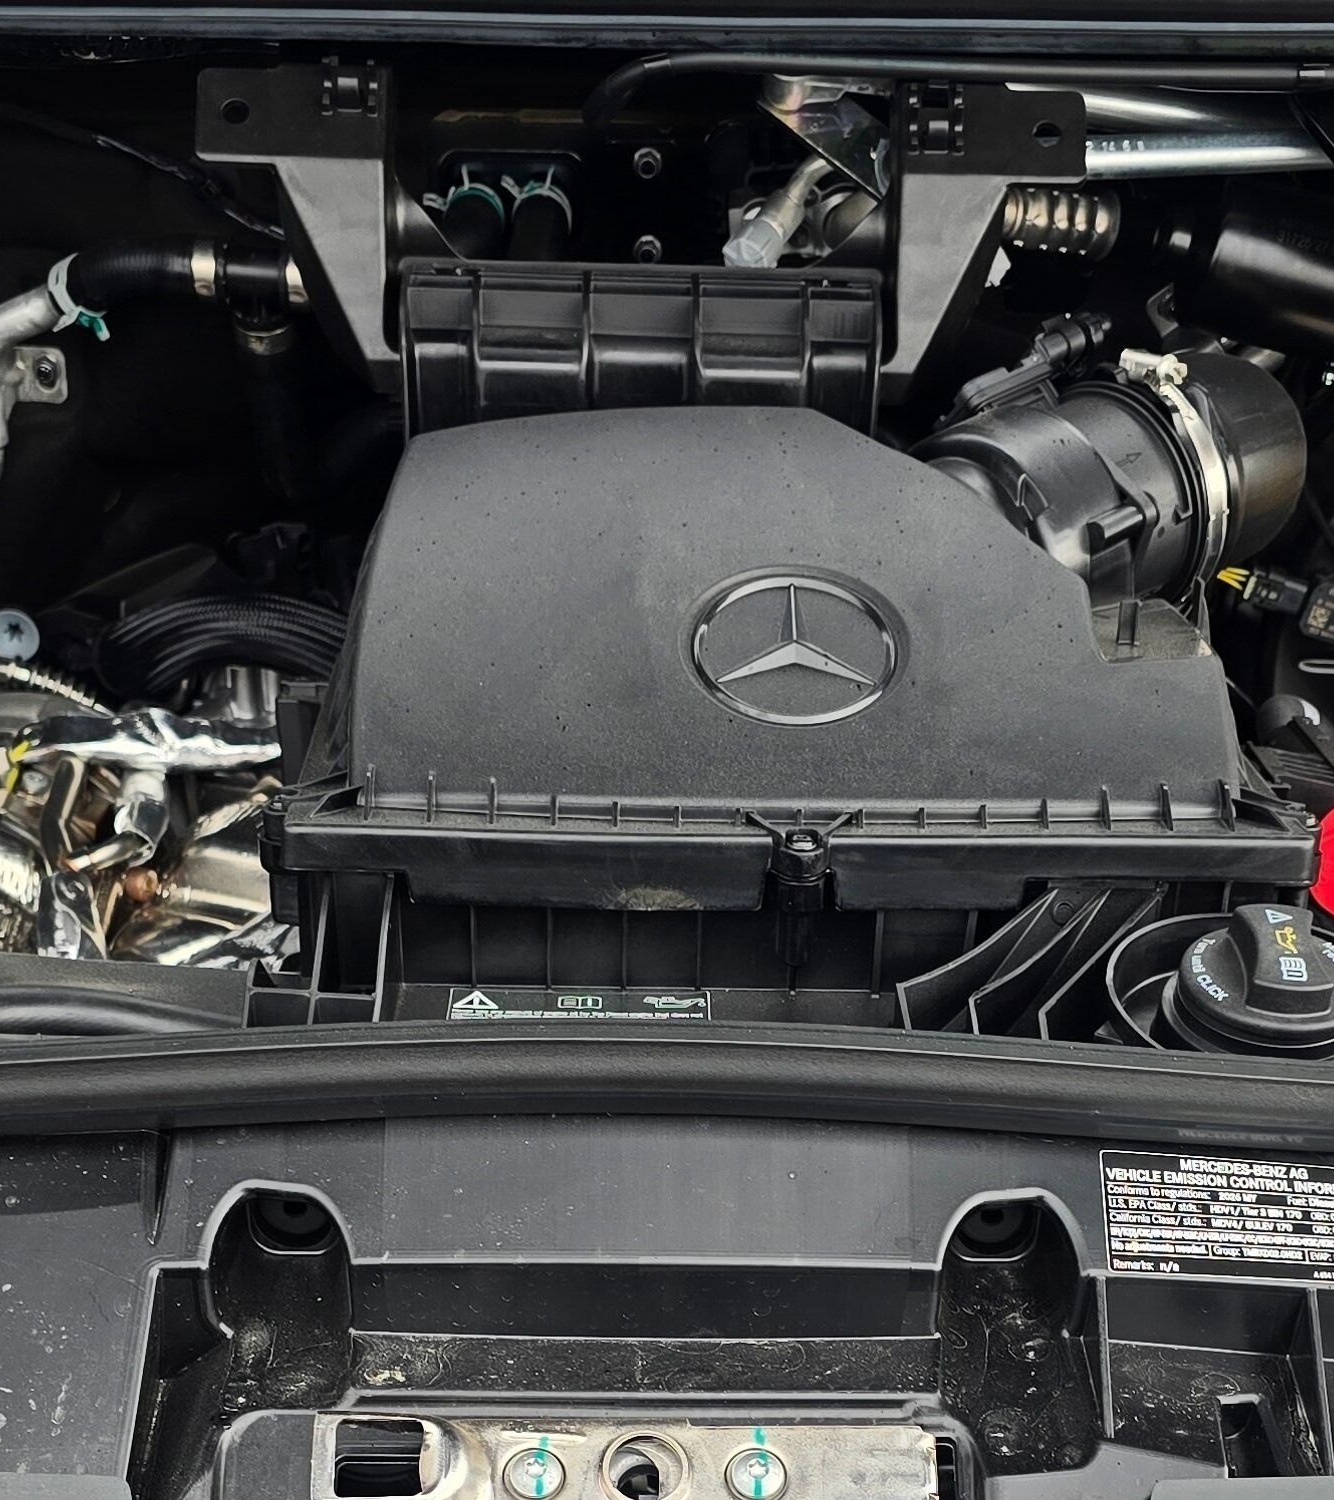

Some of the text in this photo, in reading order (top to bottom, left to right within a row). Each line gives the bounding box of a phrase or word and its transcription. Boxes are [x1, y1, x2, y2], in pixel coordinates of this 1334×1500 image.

[1197, 975, 1229, 1001] CLICK
[1179, 1159, 1309, 1180] MERCEDES-BENZ AG
[1106, 1167, 1162, 1183] VEHICLE
[1163, 1171, 1228, 1187] EMISSION
[1229, 1175, 1293, 1193] CONTROL
[1150, 1187, 1160, 1196] to
[1128, 1200, 1146, 1209] EPA
[1159, 1261, 1179, 1272] n/a
